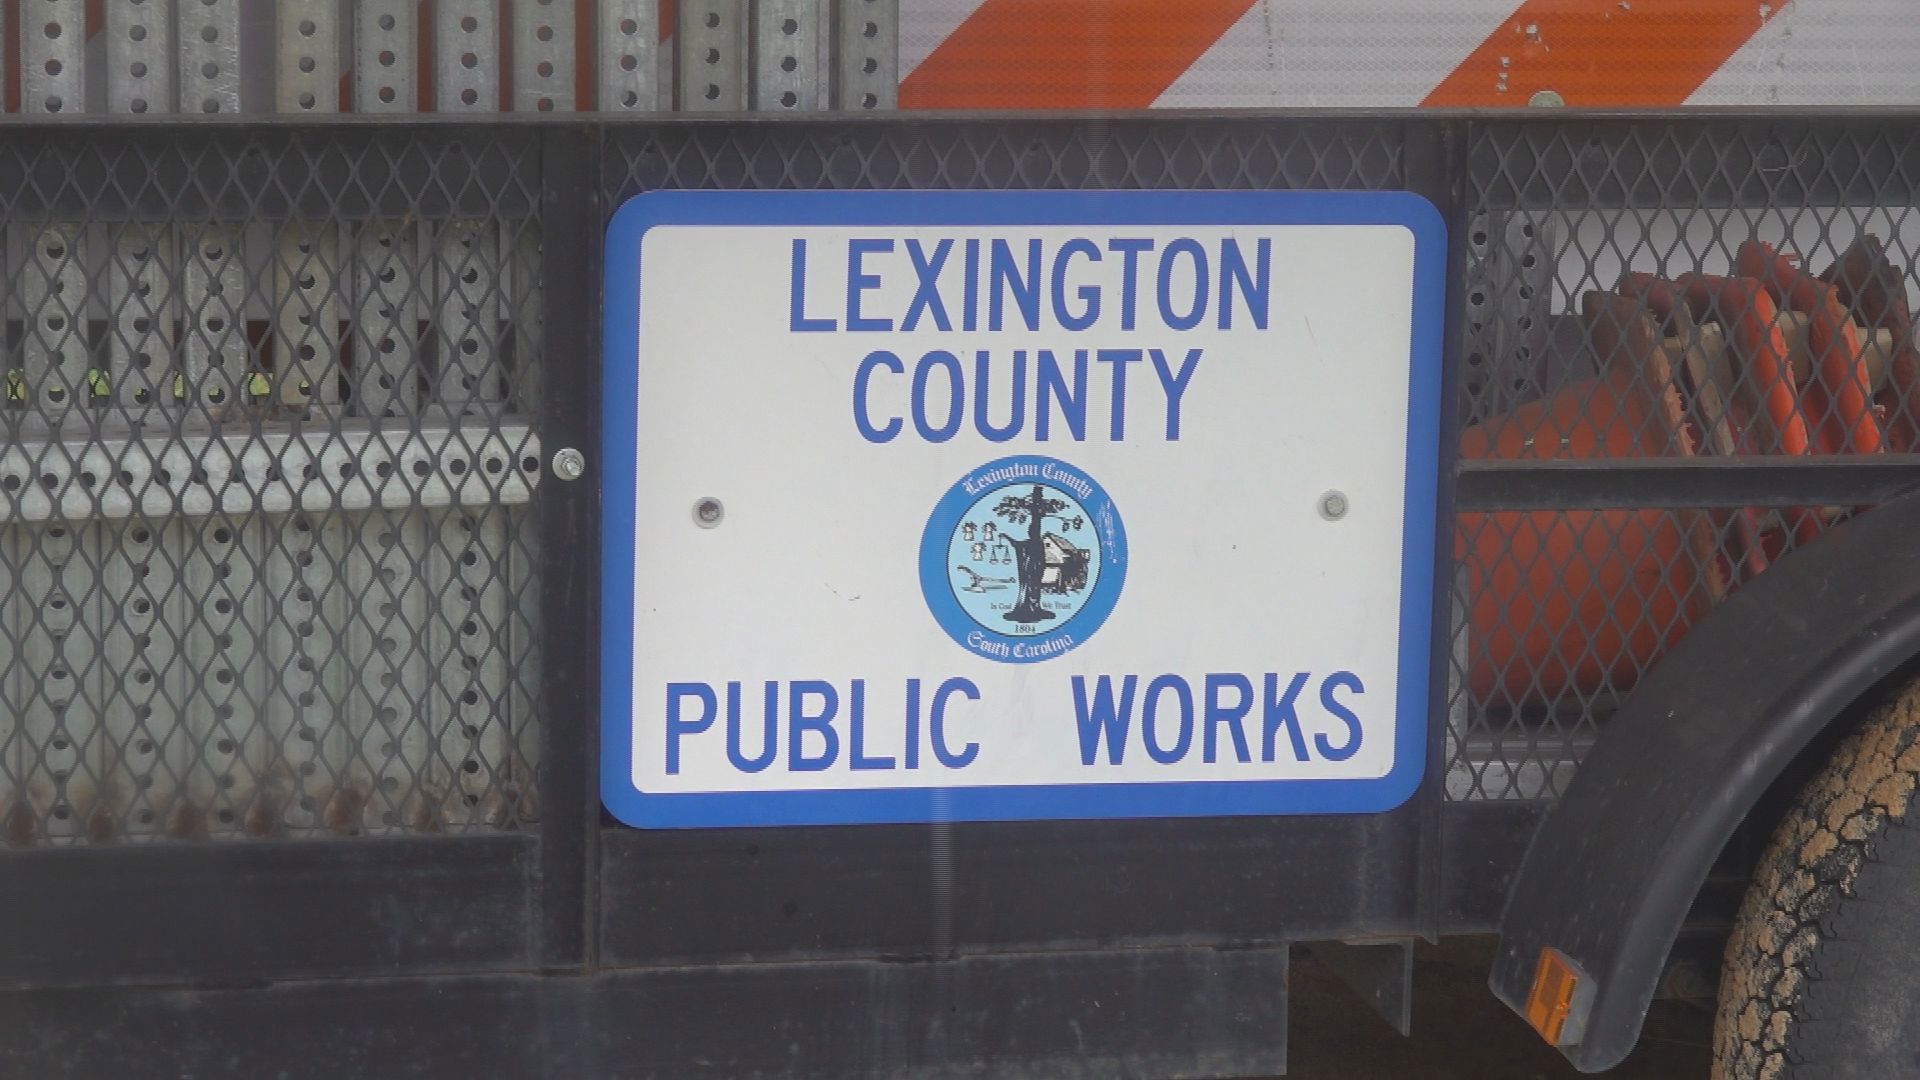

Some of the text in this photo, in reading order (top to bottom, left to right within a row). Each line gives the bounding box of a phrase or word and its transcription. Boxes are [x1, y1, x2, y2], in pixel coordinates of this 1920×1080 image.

[789, 238, 1272, 331] LEXINGTON
[852, 349, 1203, 444] COUNTY
[963, 462, 1094, 499] Lexington County
[967, 631, 1075, 658] South Carolina
[1015, 624, 1036, 634] 1804
[665, 671, 1365, 775] PUBLIC WORKS
